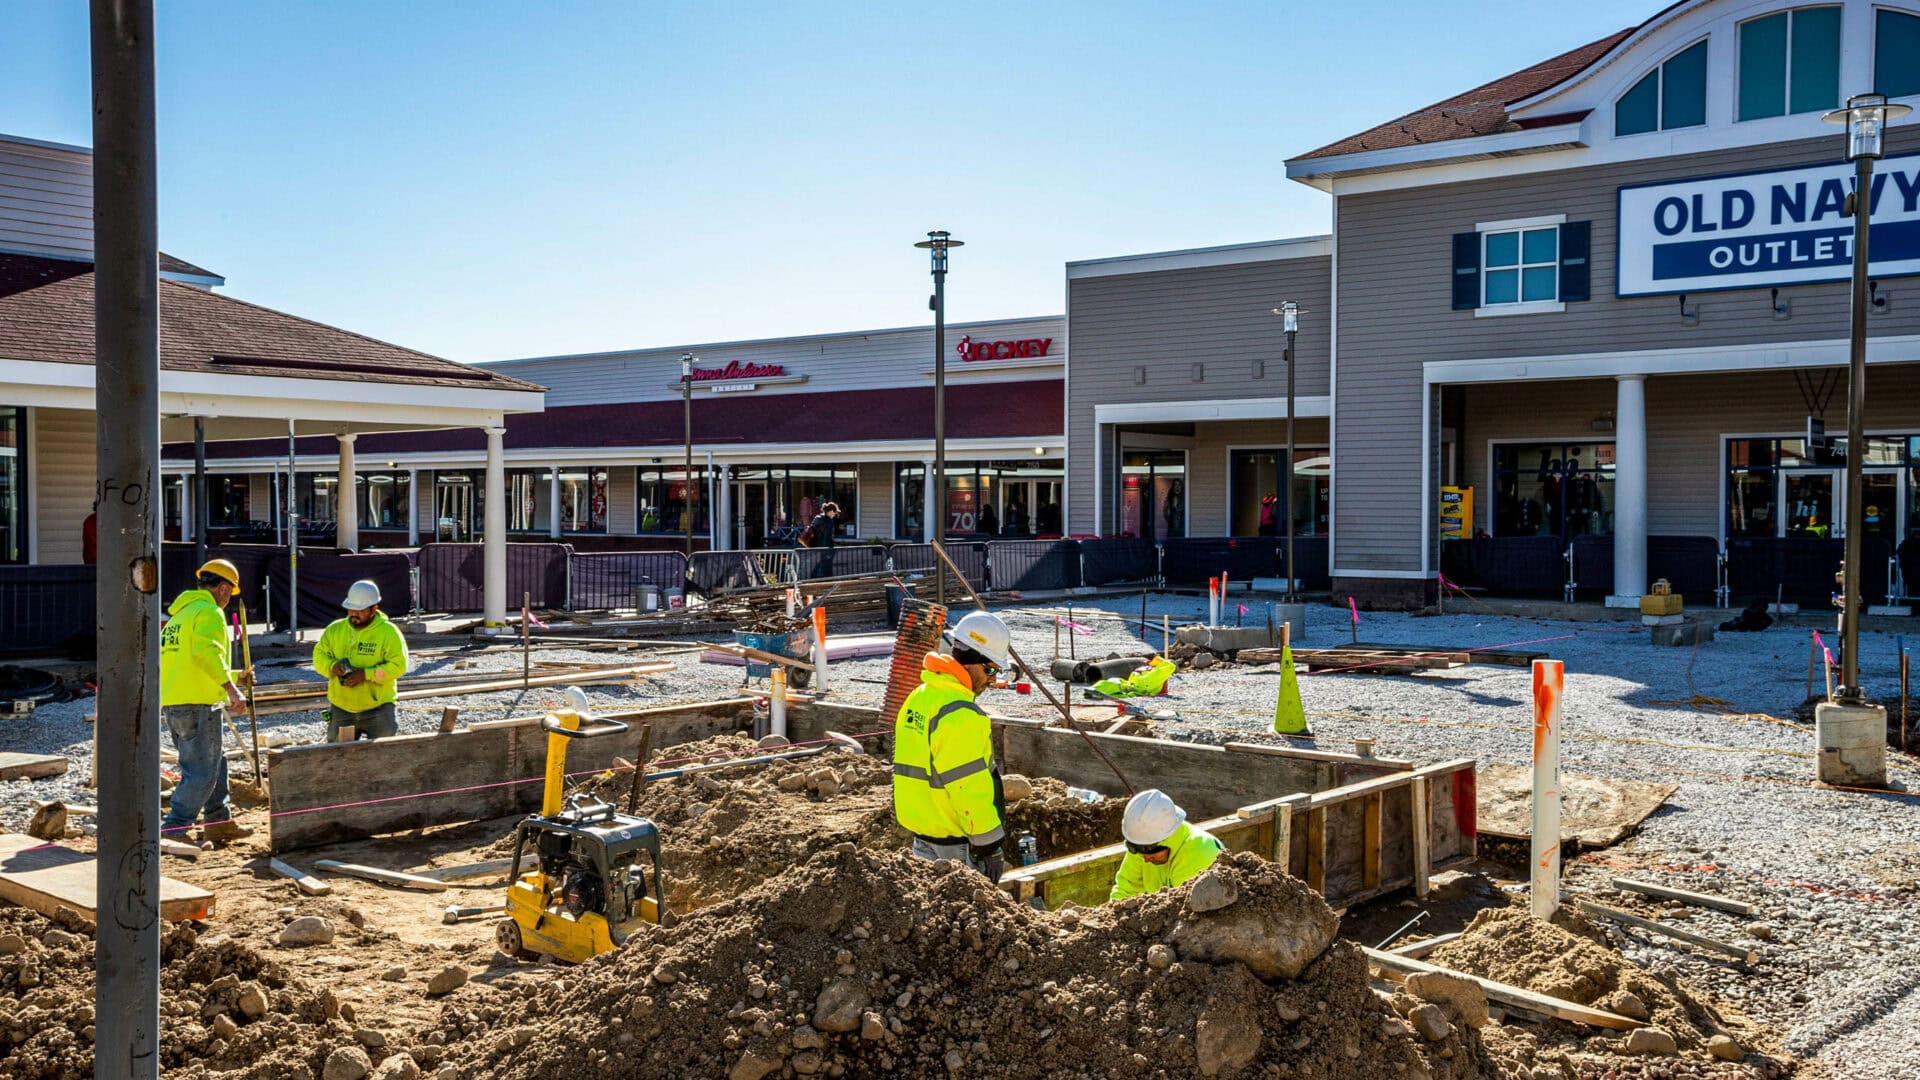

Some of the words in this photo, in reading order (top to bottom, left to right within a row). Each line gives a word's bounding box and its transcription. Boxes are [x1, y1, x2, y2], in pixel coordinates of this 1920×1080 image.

[1653, 188, 1755, 237] OLD
[1770, 170, 1920, 226] NAVY
[1708, 234, 1854, 269] OUTLET
[959, 337, 1053, 362] JOCKEY
[951, 511, 977, 531] 70
[1795, 500, 1819, 518] hi
